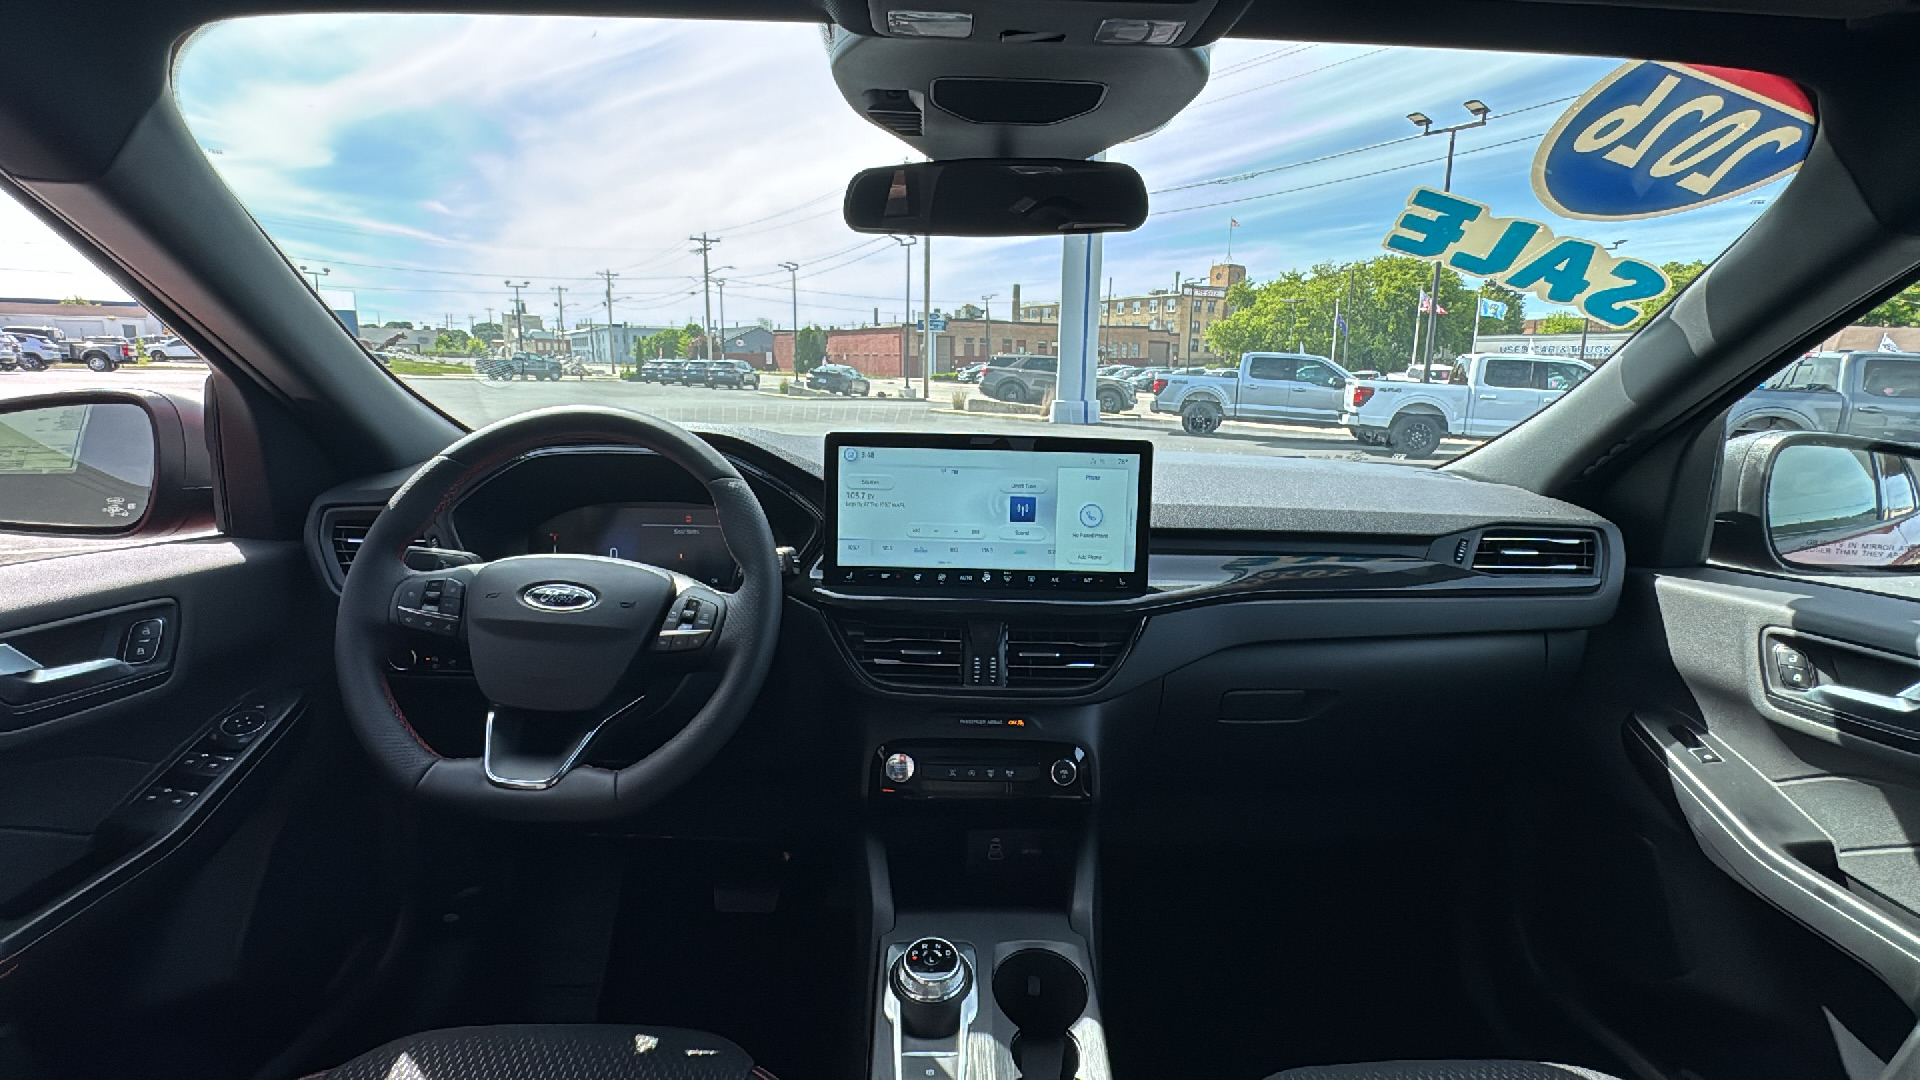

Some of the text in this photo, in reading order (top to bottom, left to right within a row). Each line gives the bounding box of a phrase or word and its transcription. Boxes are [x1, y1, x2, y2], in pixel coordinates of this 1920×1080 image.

[1500, 345, 1528, 354] USED
[846, 491, 867, 500] 105.7
[1861, 543, 1895, 551] MIRROR
[540, 588, 578, 603] Ford
